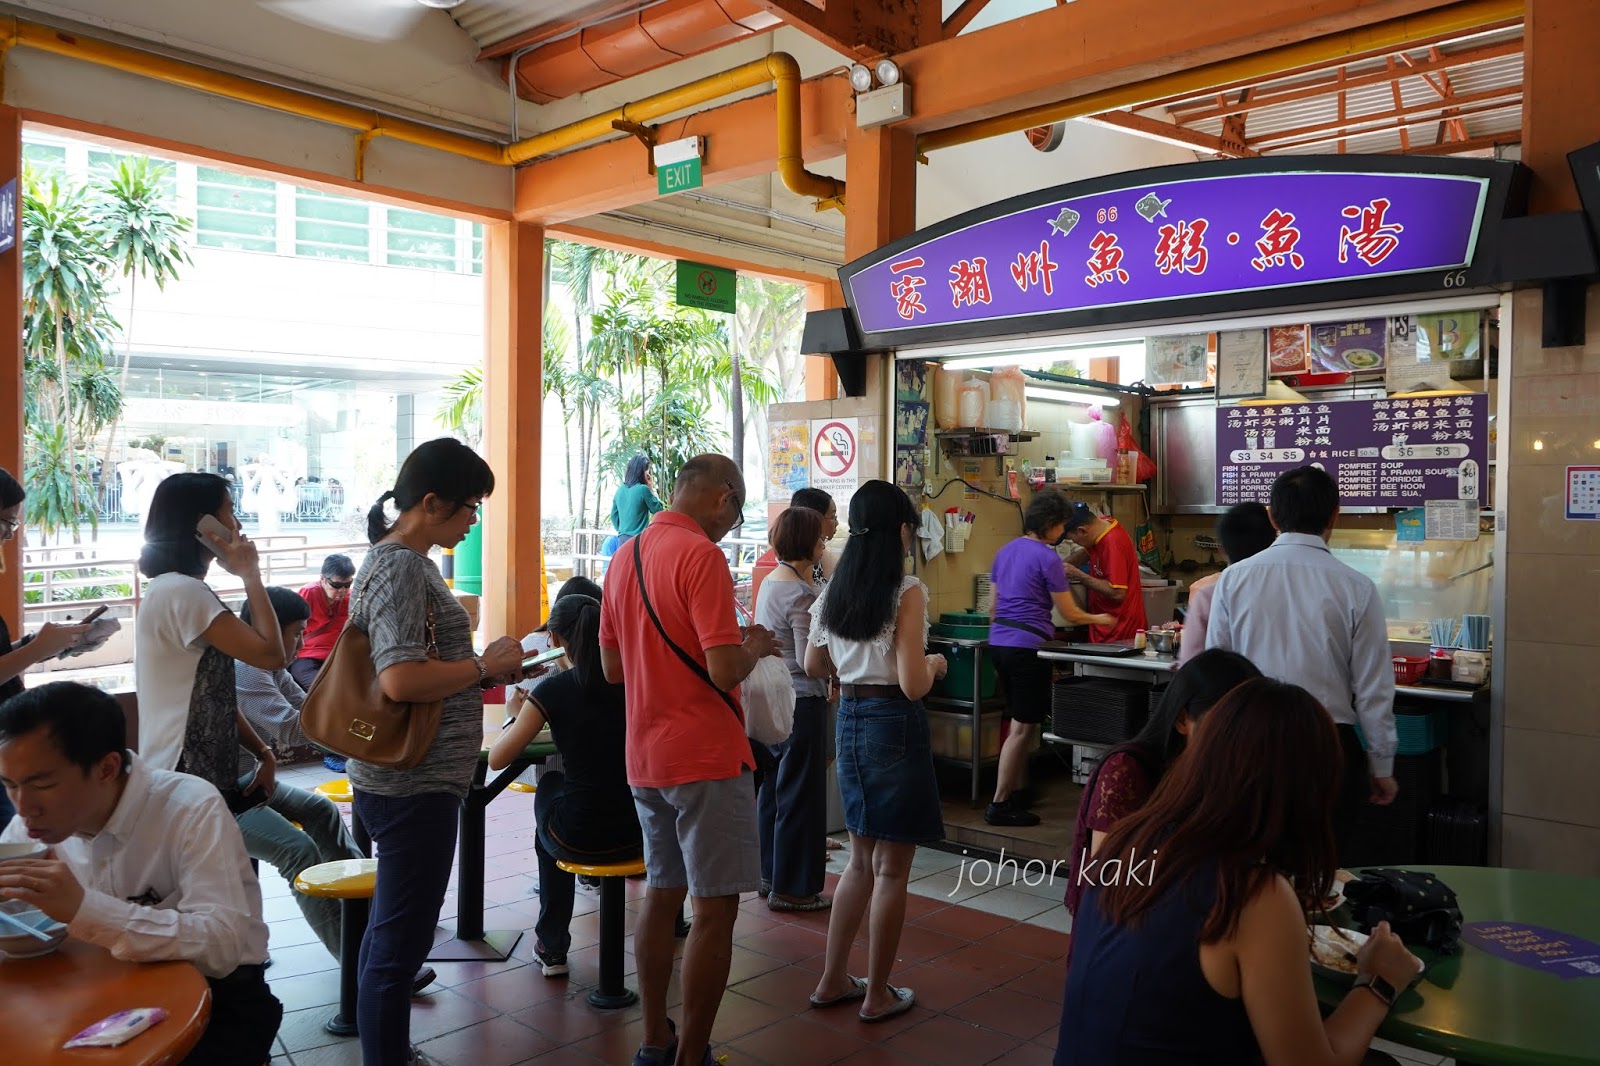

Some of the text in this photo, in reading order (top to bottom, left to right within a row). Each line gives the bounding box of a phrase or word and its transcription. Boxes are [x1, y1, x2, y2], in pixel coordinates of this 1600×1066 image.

[665, 163, 691, 189] EXIT
[1096, 206, 1118, 224] 66
[1443, 270, 1467, 289] 66
[1437, 319, 1460, 346] B
[1227, 409, 1243, 428] 鱼汤
[1278, 406, 1295, 426] 鱼粥
[1295, 405, 1313, 446] 鱼片米粉
[1331, 450, 1356, 458] RICE
[1398, 447, 1450, 457] $6 $8
